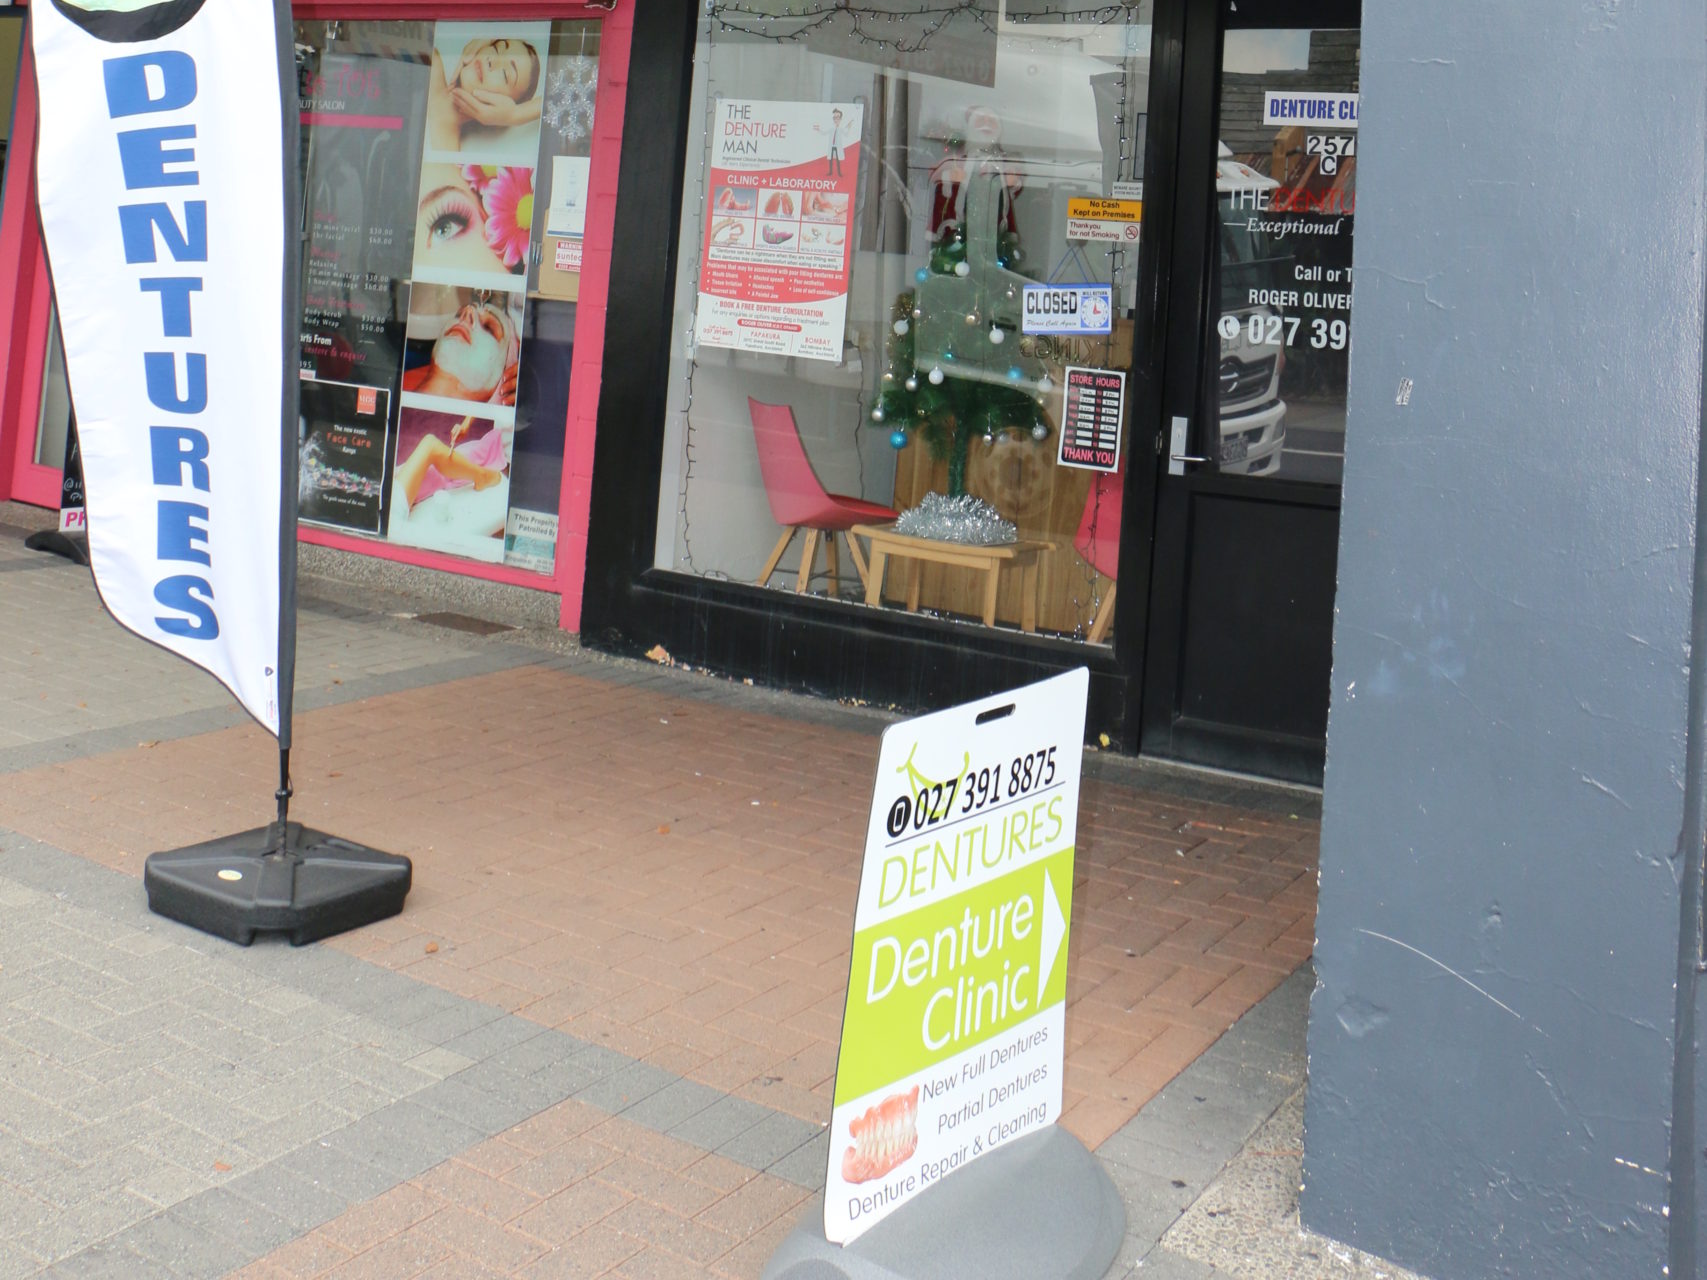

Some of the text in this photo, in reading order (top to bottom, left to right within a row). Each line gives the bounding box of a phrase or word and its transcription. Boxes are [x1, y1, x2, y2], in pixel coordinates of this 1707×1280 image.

[727, 104, 751, 120] THE
[1270, 98, 1335, 119] DENTURE
[724, 121, 787, 139] DENTURE
[722, 140, 758, 155] MAN
[1308, 136, 1353, 155] 257
[1321, 155, 1336, 173] C
[727, 174, 759, 187] CLINIC
[769, 178, 837, 191] LABORATORY
[1089, 200, 1120, 209] No Cash
[1229, 186, 1355, 214] THE DENTU
[1073, 208, 1090, 217] Kept
[1102, 210, 1135, 219] Premises
[1070, 221, 1101, 230] Thankyou
[1070, 229, 1120, 240] for not Smoking
[1246, 217, 1344, 240] Exceptional
[1294, 264, 1322, 281] Call
[1326, 270, 1341, 282] or
[1027, 291, 1077, 315] CLOSED
[1248, 289, 1352, 310] ROGER OLIVER
[720, 301, 735, 309] BOOK
[741, 303, 754, 311] FREE
[756, 304, 781, 313] DENTURE
[782, 306, 824, 318] CONSULTATION
[314, 334, 332, 345] From
[750, 331, 781, 341] PAPAKURA
[805, 336, 831, 346] BOMBAY
[1248, 314, 1350, 350] 027 39
[103, 50, 219, 641] DENTURES
[1070, 373, 1120, 388] STORE HOURS
[326, 431, 371, 448] Face Care
[1064, 446, 1115, 465] THANK YOU
[914, 746, 1057, 830] 027 391 8875
[878, 795, 1063, 909] DENTURES
[867, 893, 1034, 1004] Denture
[921, 960, 1031, 1052] Clinic
[923, 1026, 1048, 1103] New Full Dentures
[938, 1064, 1048, 1135] Partial Dentures
[848, 1102, 1047, 1221] Denture Repair & Cleaning
